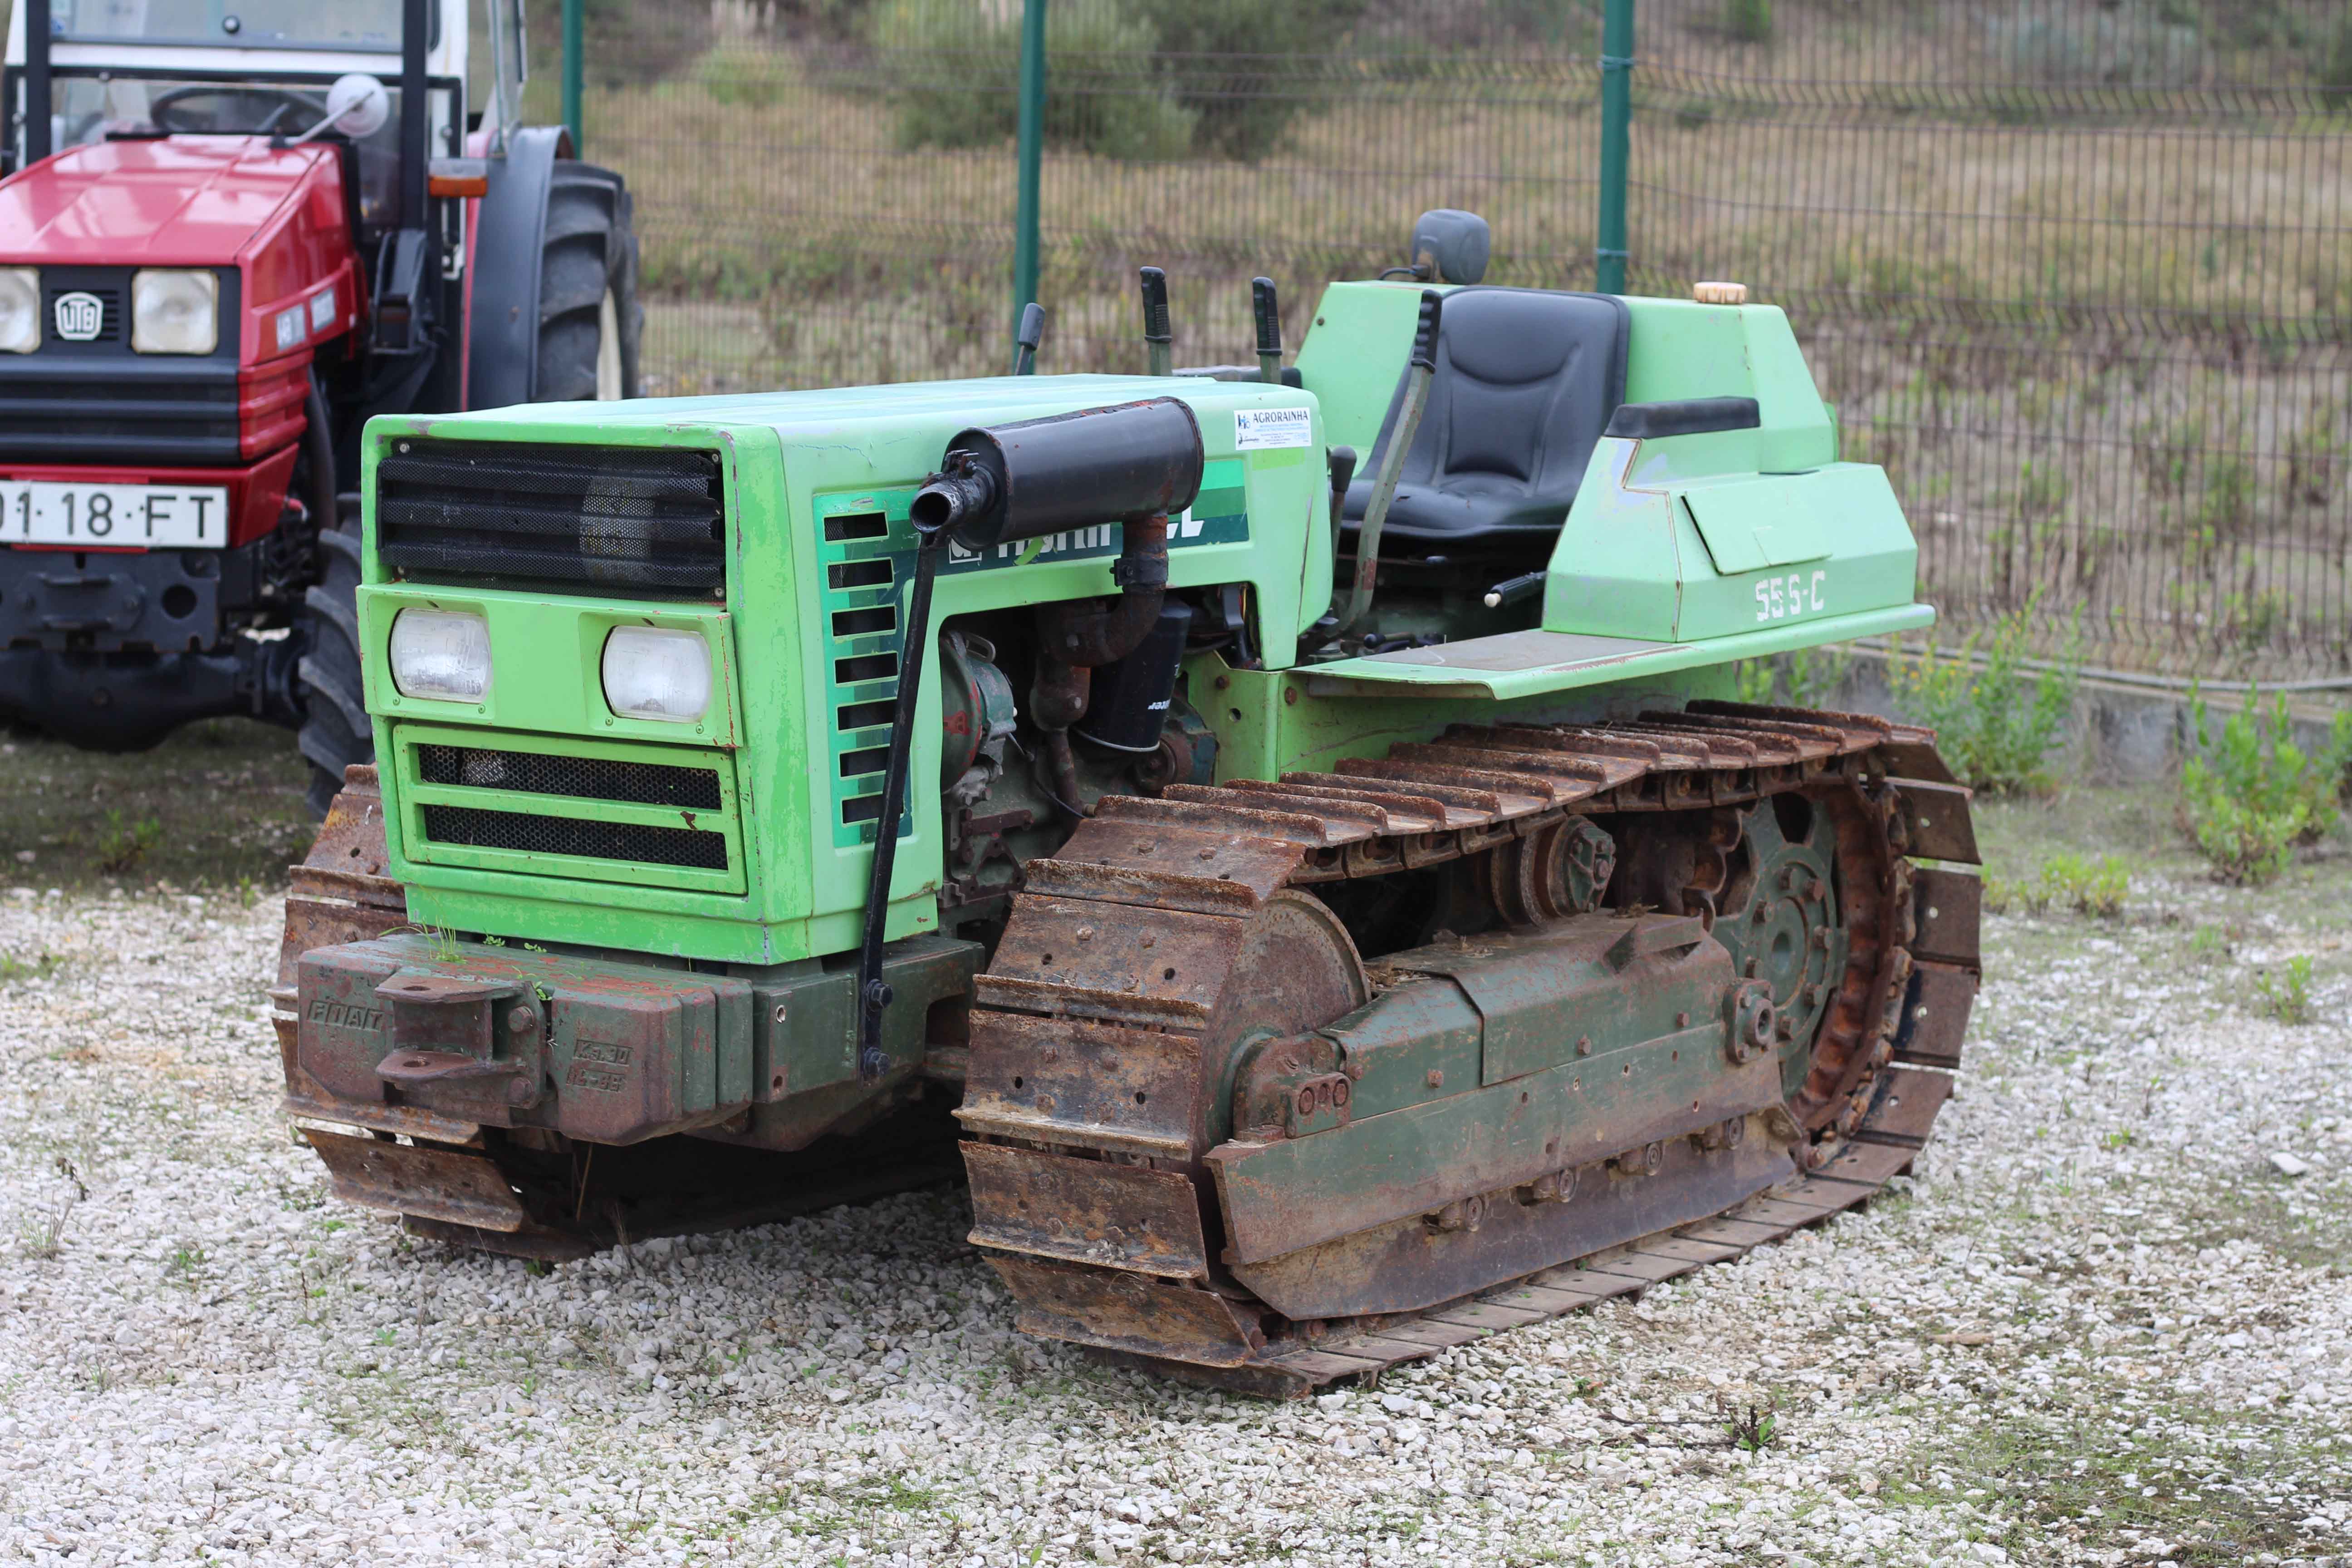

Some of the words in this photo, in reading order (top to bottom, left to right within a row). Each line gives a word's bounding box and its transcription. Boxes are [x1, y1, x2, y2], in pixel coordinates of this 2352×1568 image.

[62, 301, 95, 330] UTB
[1253, 411, 1308, 423] AGRORAINHA
[312, 1004, 383, 1029] FIAT
